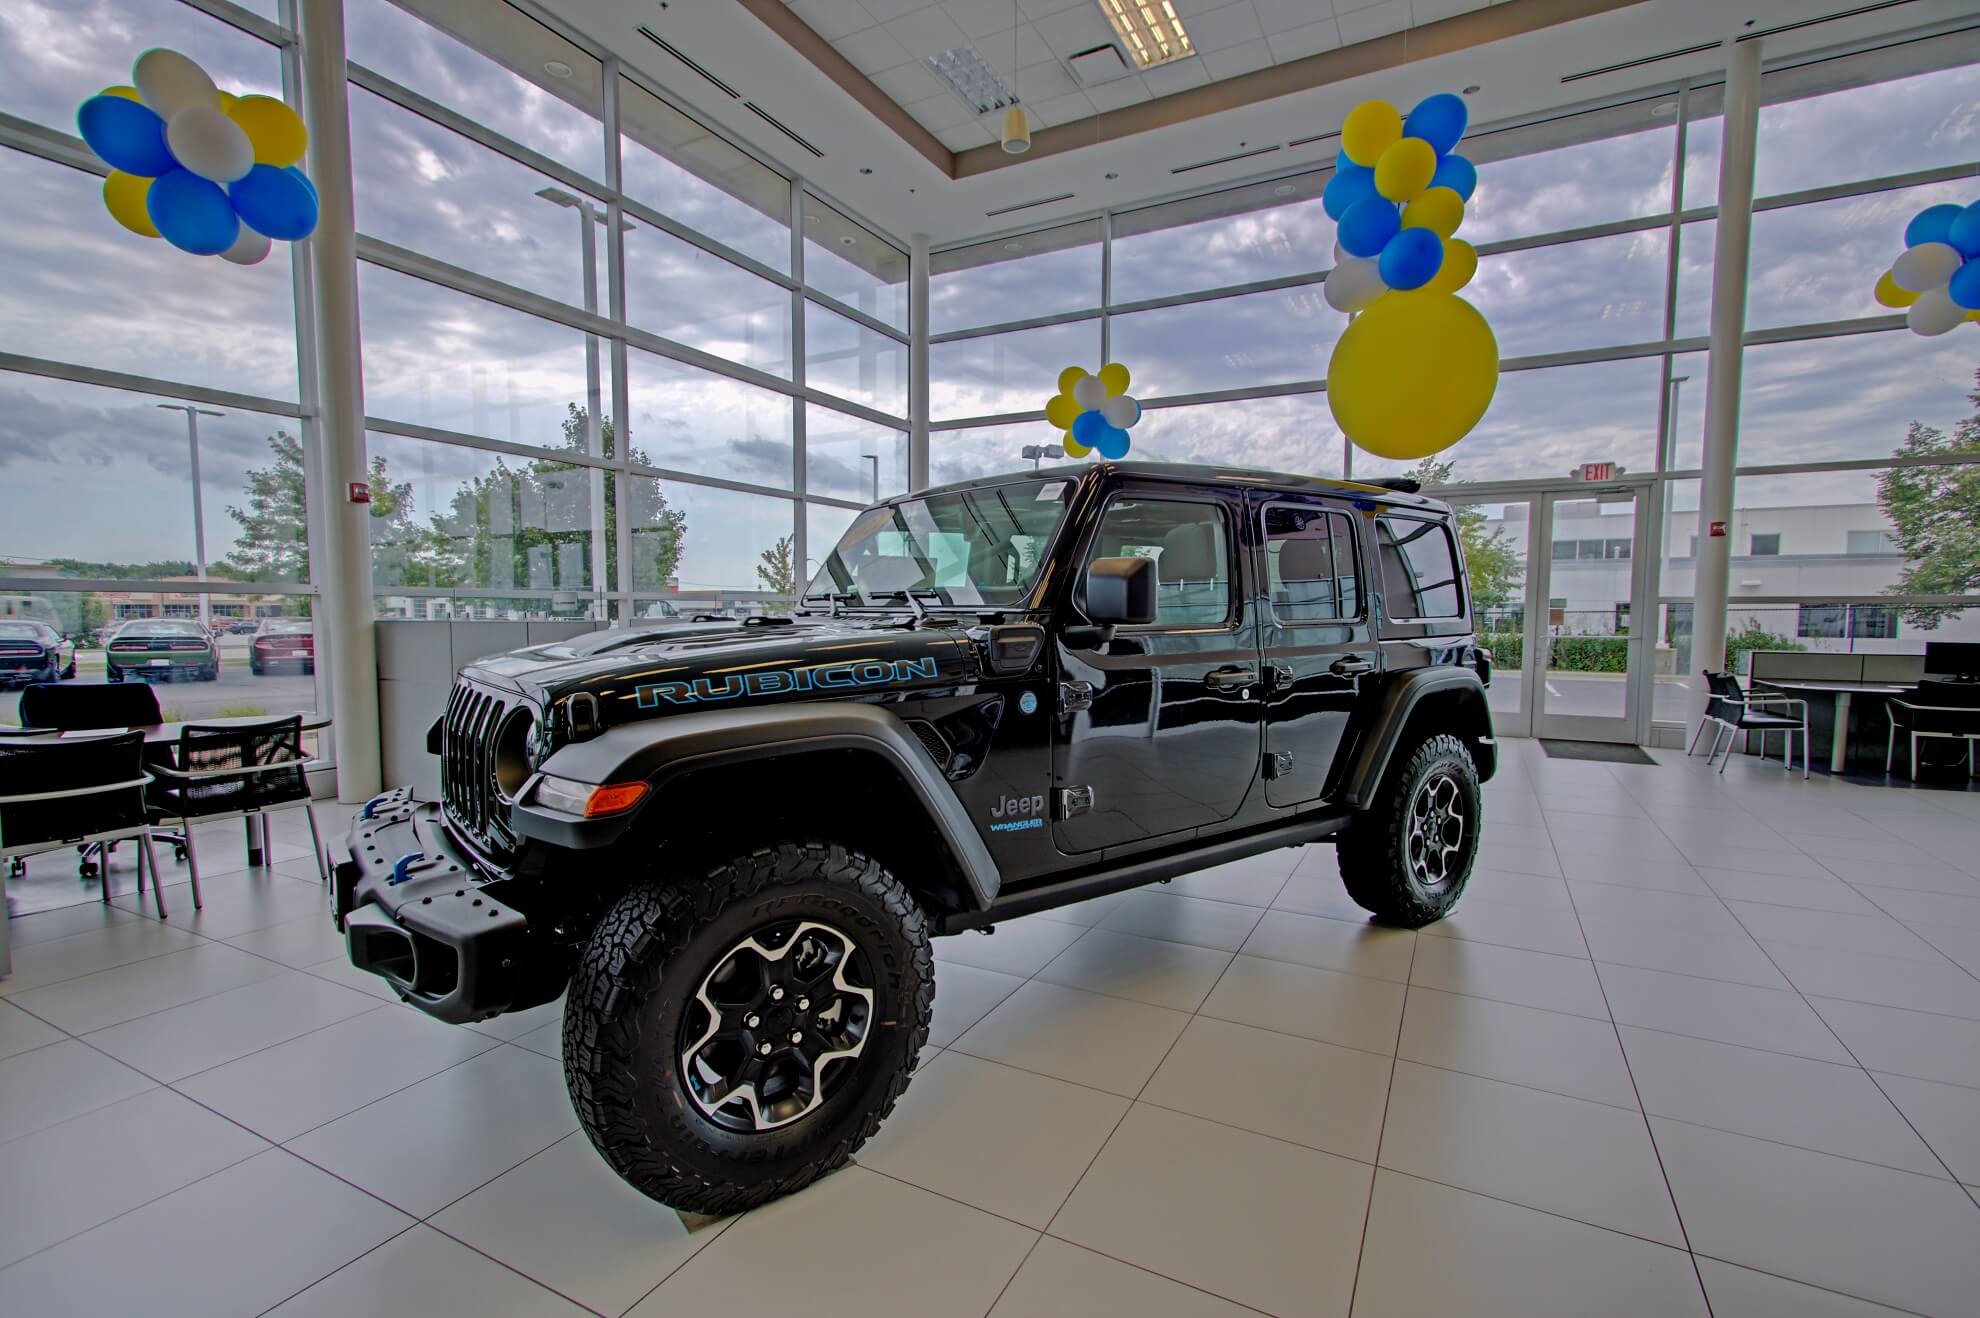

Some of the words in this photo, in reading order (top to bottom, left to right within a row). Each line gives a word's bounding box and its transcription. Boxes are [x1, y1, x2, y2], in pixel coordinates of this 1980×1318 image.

[1585, 463, 1609, 480] EXIT
[635, 656, 939, 709] RUBICON
[991, 795, 1044, 818] Jeep
